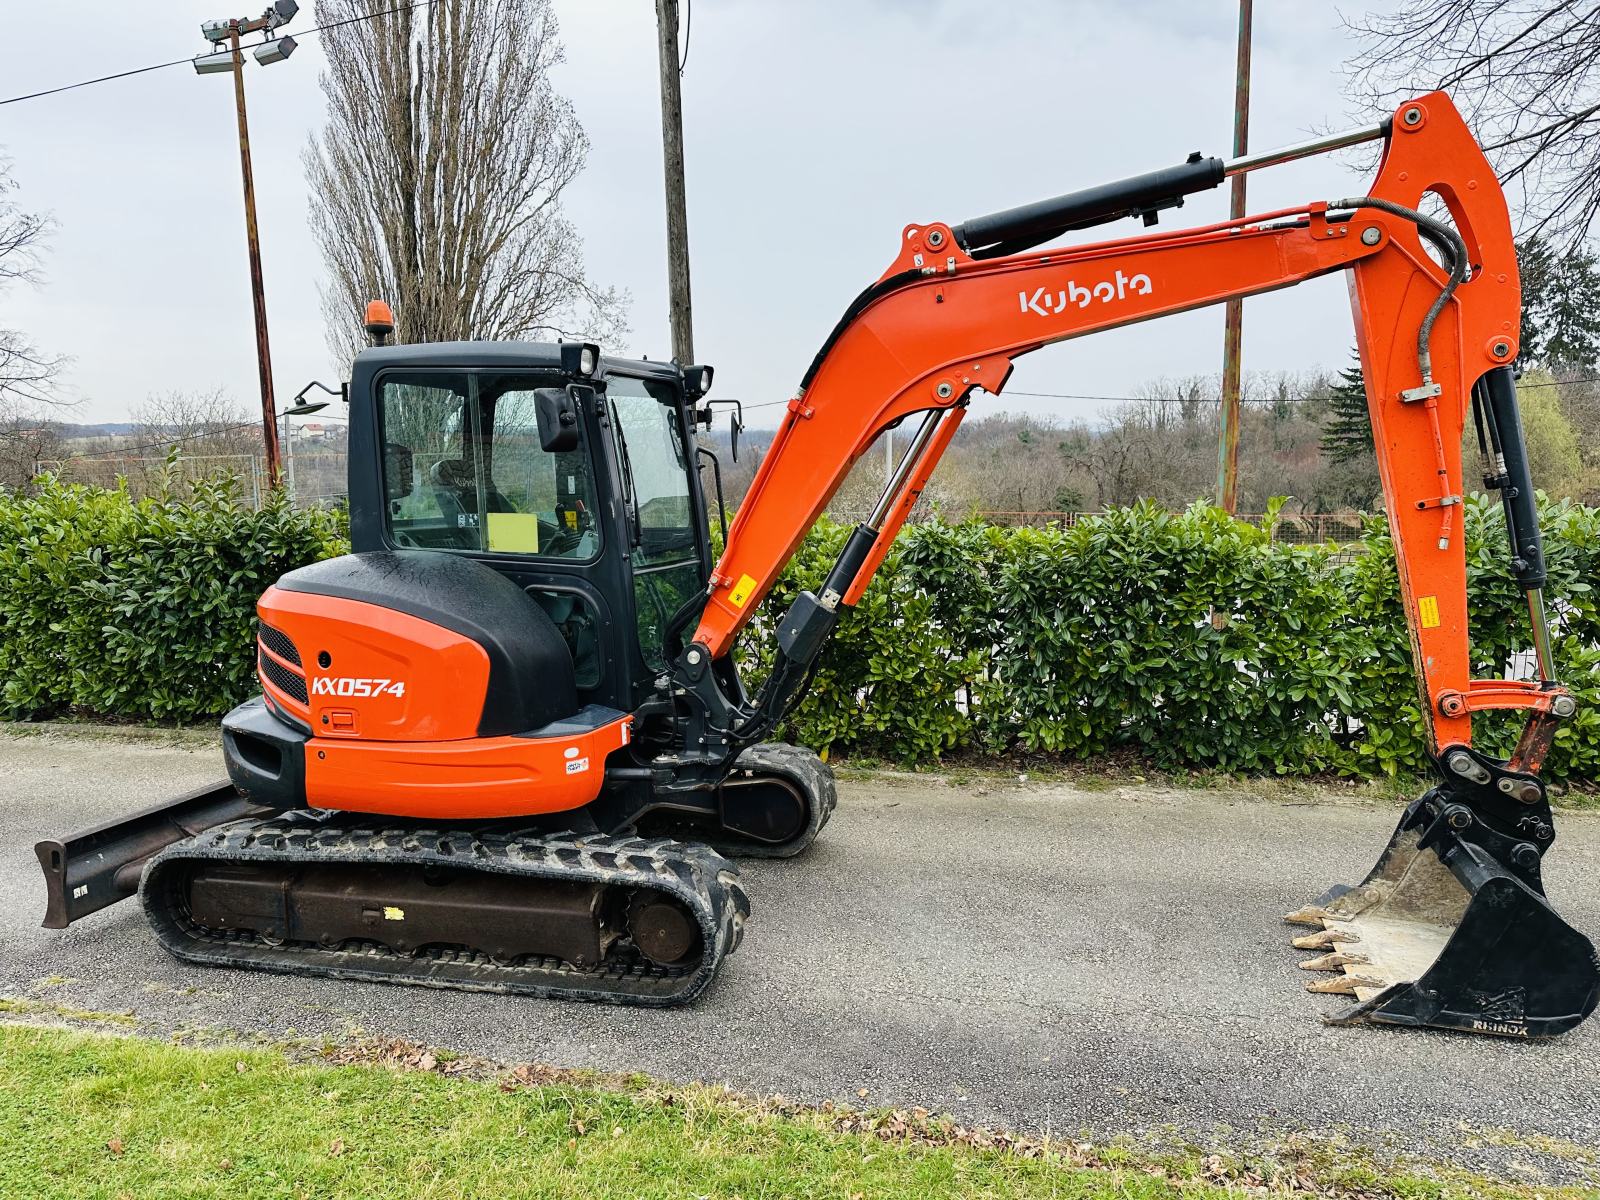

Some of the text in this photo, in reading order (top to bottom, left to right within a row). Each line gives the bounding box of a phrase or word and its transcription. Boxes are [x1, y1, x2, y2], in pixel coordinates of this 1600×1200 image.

[1018, 270, 1153, 317] Kubota
[311, 676, 405, 698] KX057-4
[1473, 1019, 1528, 1036] RHINOX
